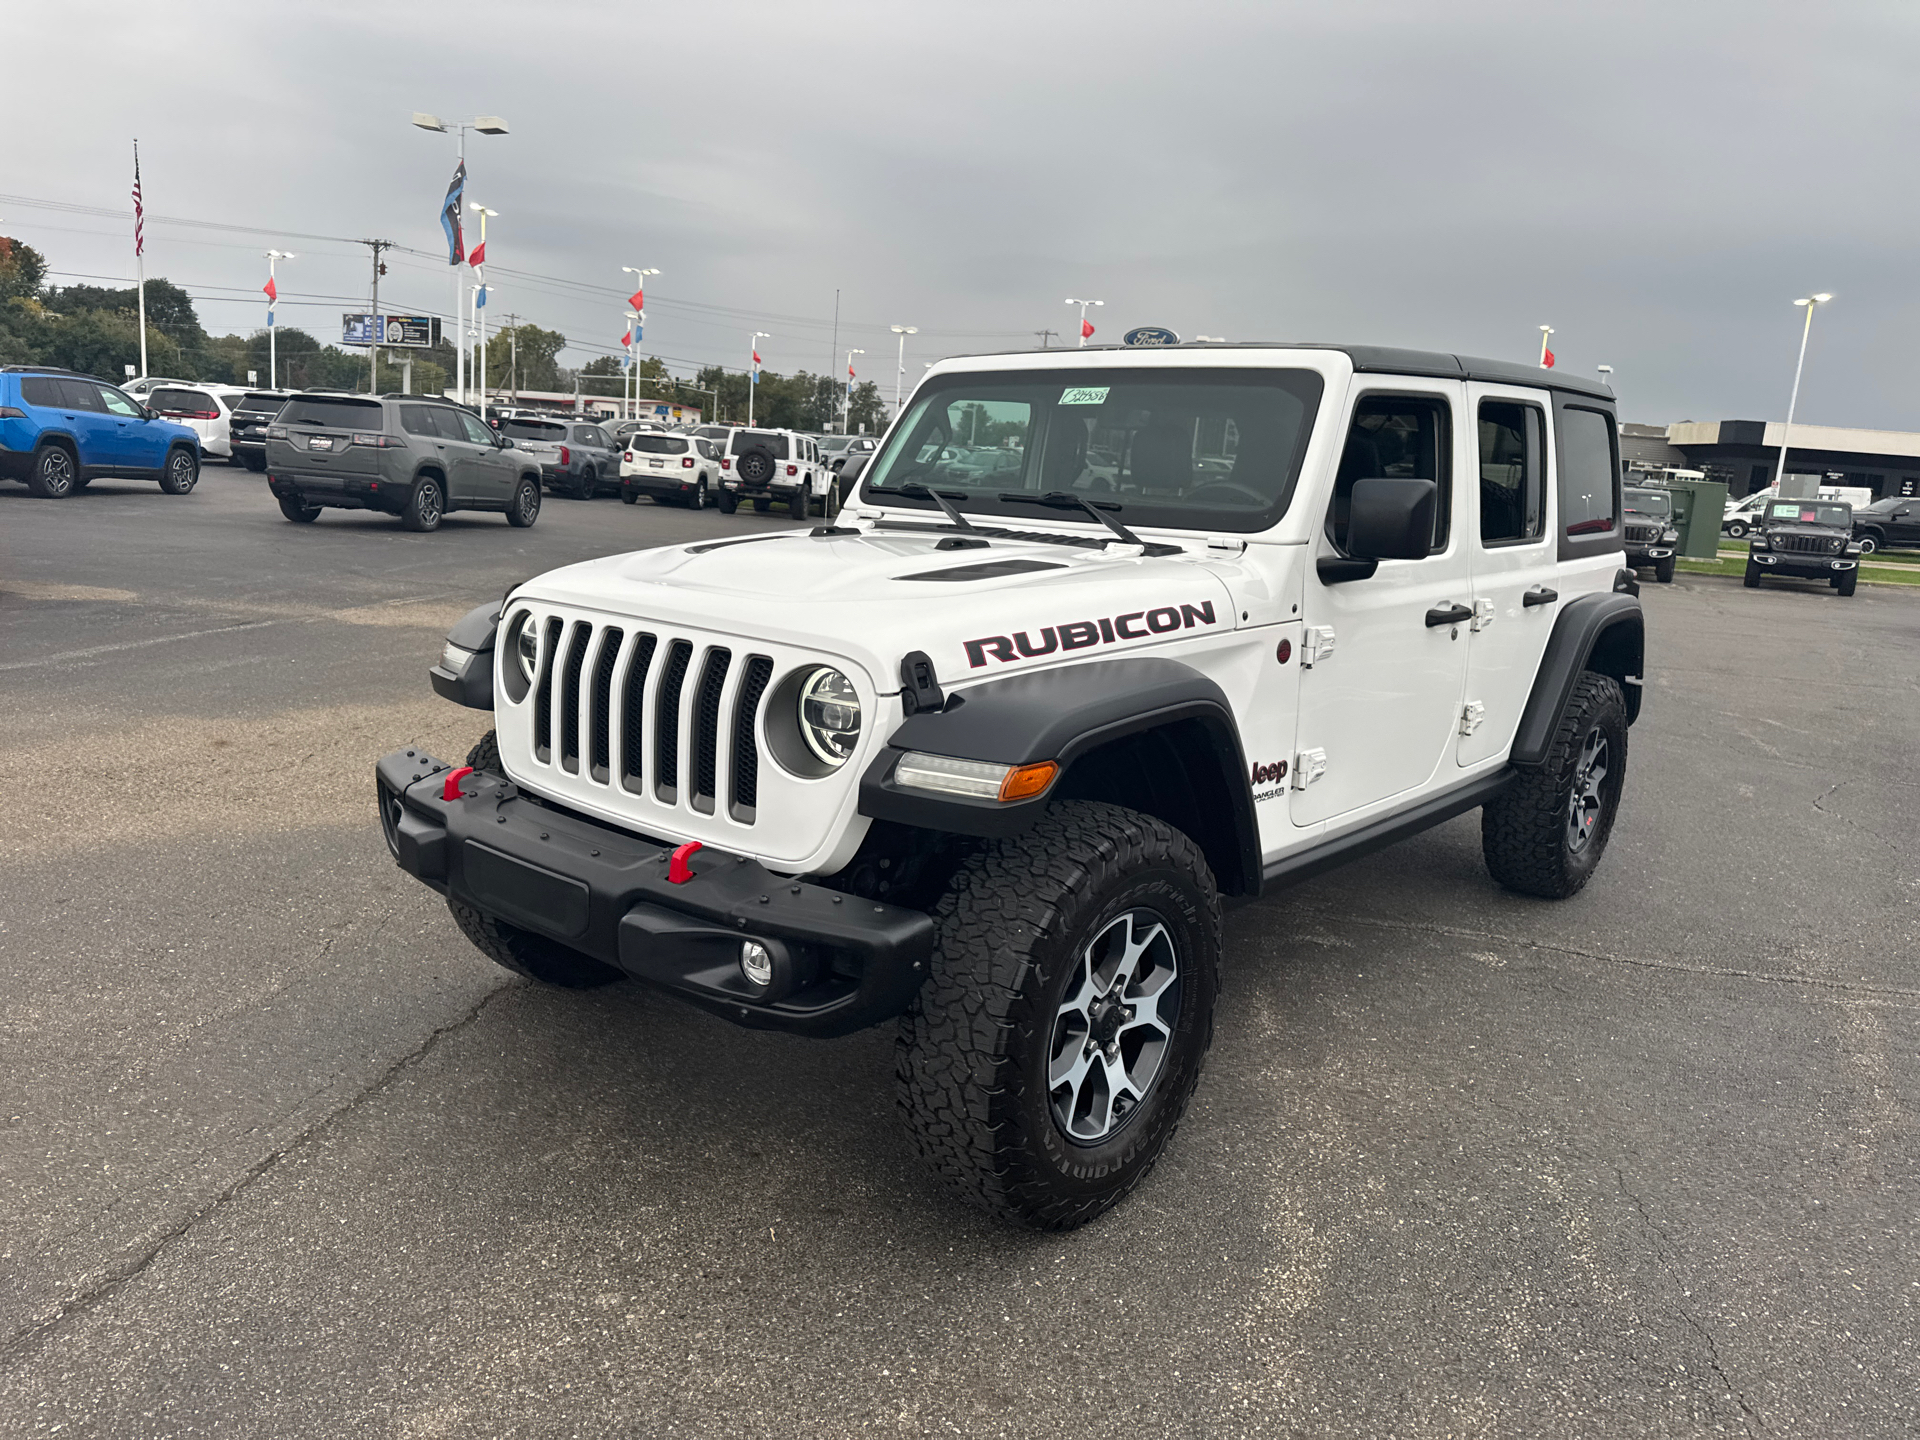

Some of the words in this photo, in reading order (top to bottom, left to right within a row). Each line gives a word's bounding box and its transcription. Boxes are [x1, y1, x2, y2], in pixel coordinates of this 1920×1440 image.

[1133, 331, 1167, 346] Ford
[962, 600, 1217, 669] RUBICON
[1251, 759, 1288, 787] Jeep
[1253, 787, 1285, 800] ANGLER
